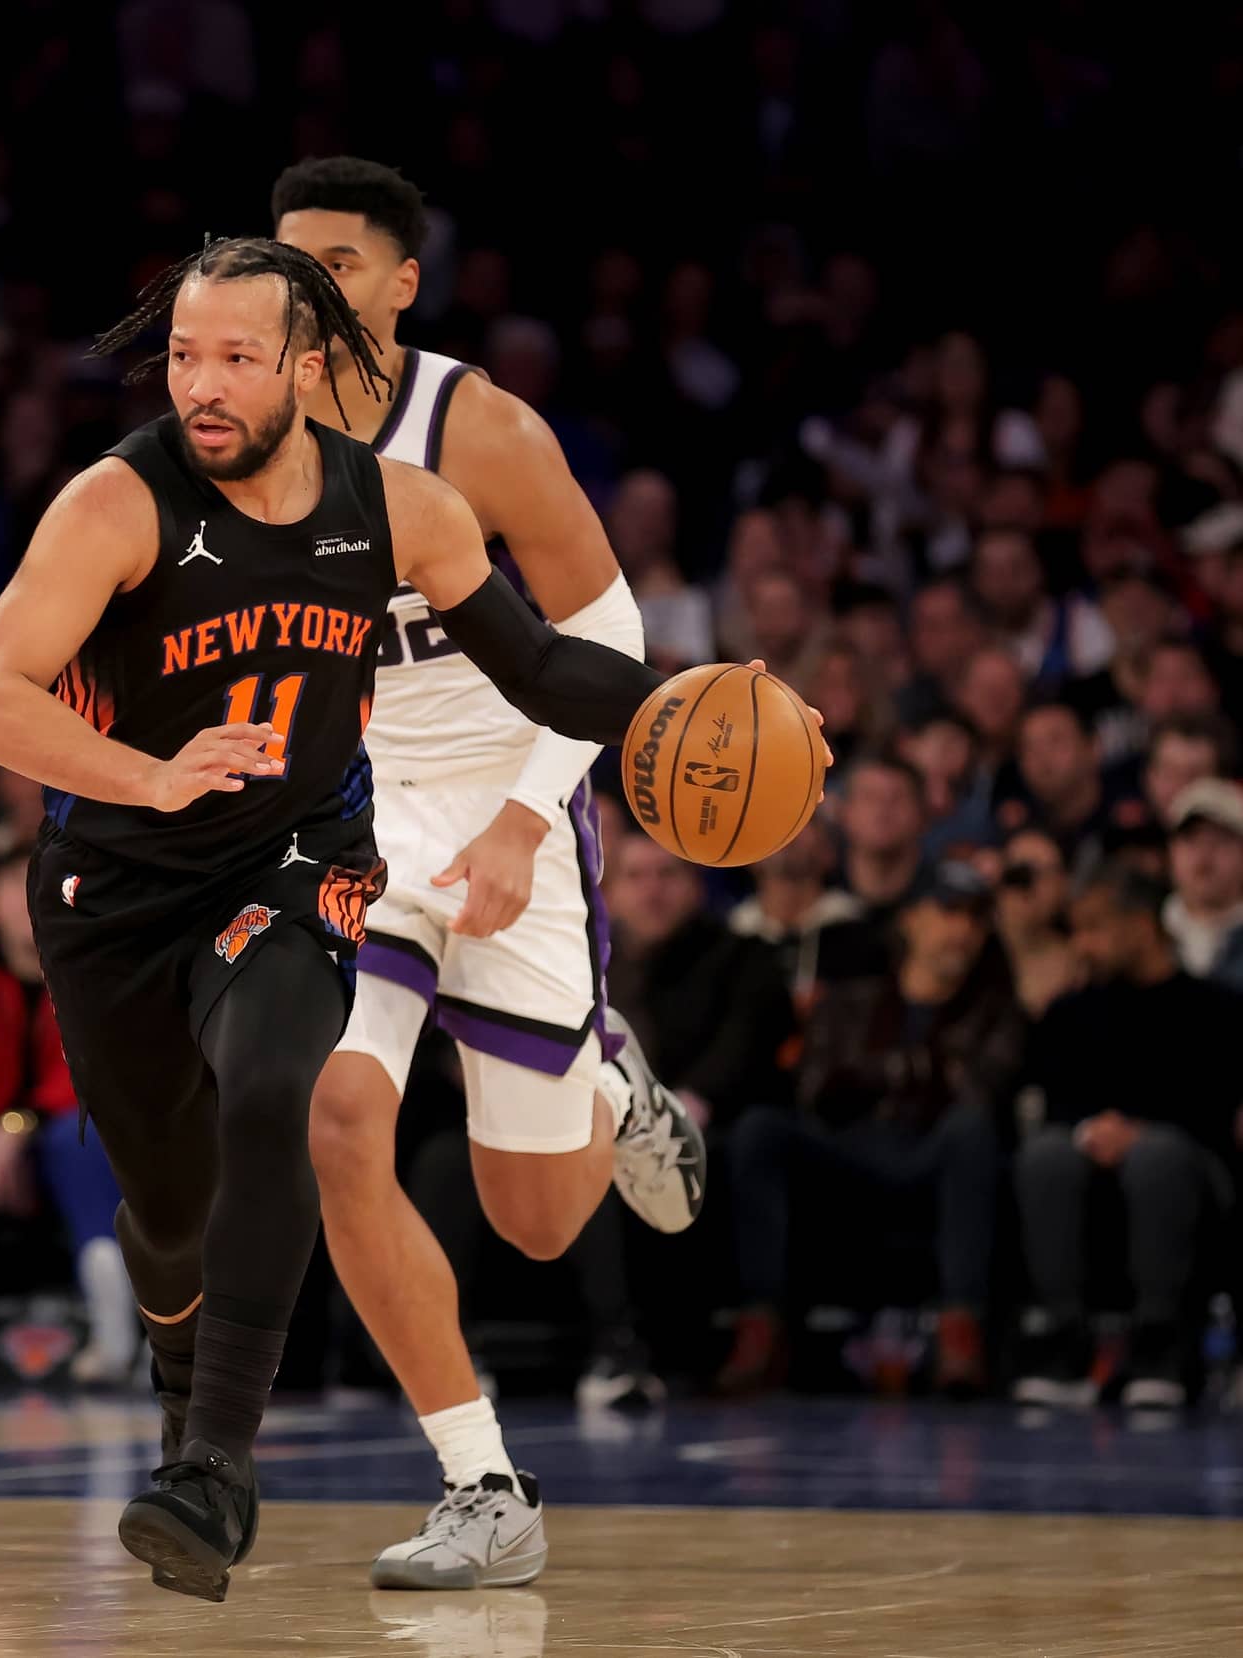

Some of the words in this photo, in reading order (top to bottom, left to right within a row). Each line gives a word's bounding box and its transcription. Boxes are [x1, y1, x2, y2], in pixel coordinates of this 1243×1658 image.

[315, 545, 336, 556] abu
[336, 539, 370, 553] dhabi
[161, 604, 267, 677] NEW
[270, 602, 373, 658] YORK
[633, 696, 686, 826] Wilson
